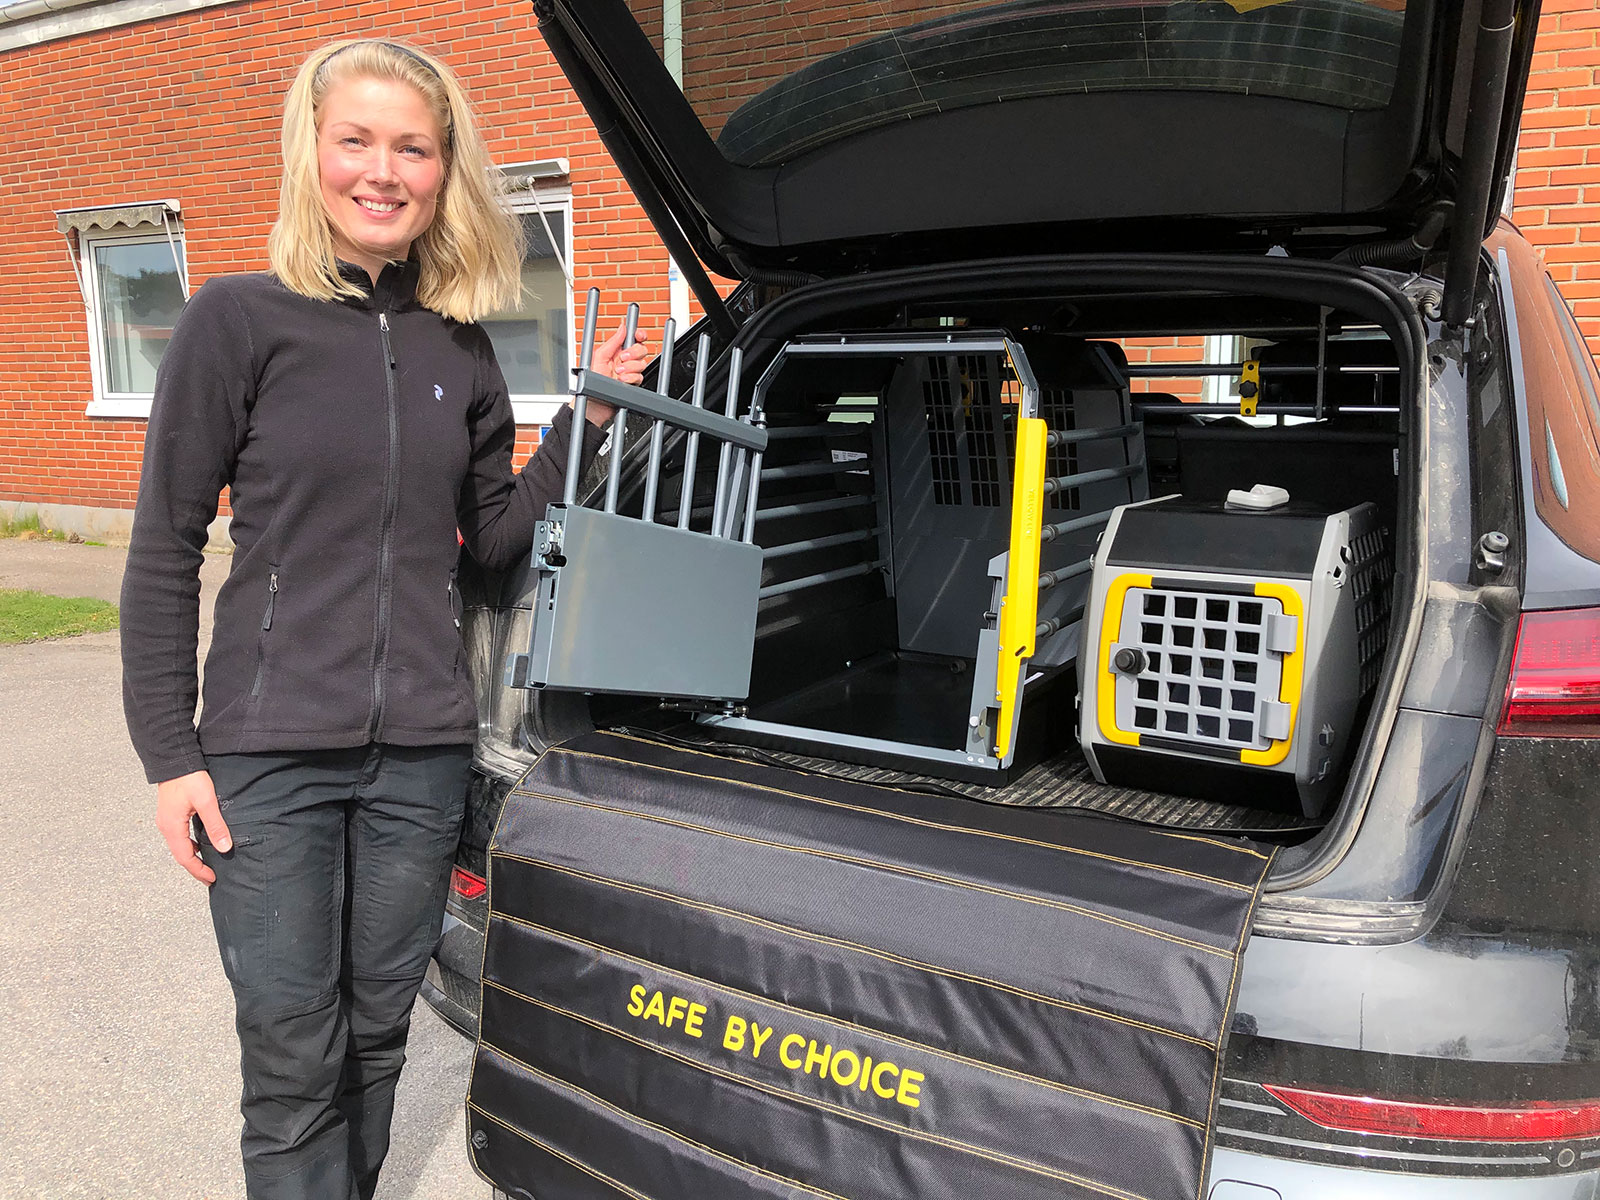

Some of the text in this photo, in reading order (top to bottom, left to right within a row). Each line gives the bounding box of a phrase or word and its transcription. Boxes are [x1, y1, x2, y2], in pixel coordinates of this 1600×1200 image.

[626, 984, 925, 1108] SAFE BY CHOICE
